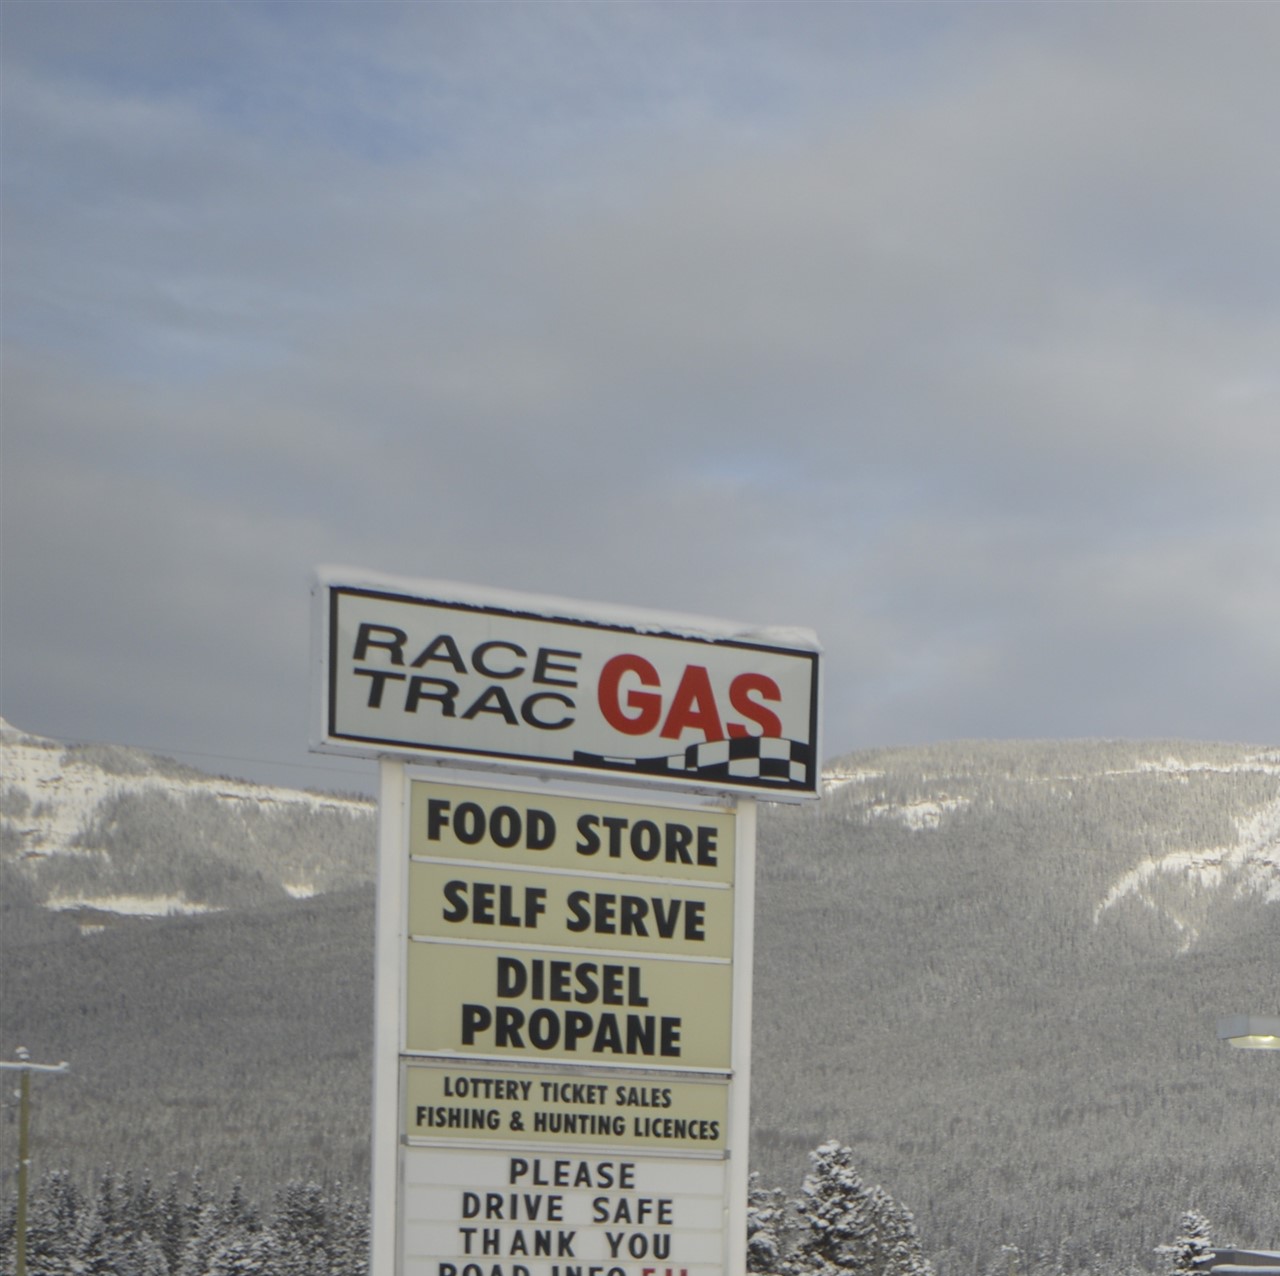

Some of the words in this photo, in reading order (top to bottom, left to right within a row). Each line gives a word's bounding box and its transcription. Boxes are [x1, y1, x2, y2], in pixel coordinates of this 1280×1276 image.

[353, 622, 582, 688] RACE
[353, 667, 576, 731] TRAC
[598, 653, 782, 741] GAS
[427, 798, 556, 851] FOOD
[576, 814, 718, 867] STORE
[443, 880, 547, 928] SELF
[566, 890, 706, 941] SERVE
[497, 957, 649, 1008] DIESEL
[461, 1003, 682, 1057] PROPANE
[443, 1076, 533, 1101] LOTTERY
[541, 1081, 608, 1105] TICKET
[615, 1085, 672, 1108] SALES
[416, 1105, 500, 1131] FISHING
[509, 1110, 525, 1132] &
[534, 1112, 626, 1137] HUNTING
[633, 1116, 720, 1141] LICENCES
[509, 1157, 636, 1190] PLEASE
[461, 1191, 564, 1222] DRIVE
[592, 1196, 673, 1226] SAFE
[459, 1227, 577, 1258] THANK
[605, 1231, 672, 1260] YOU
